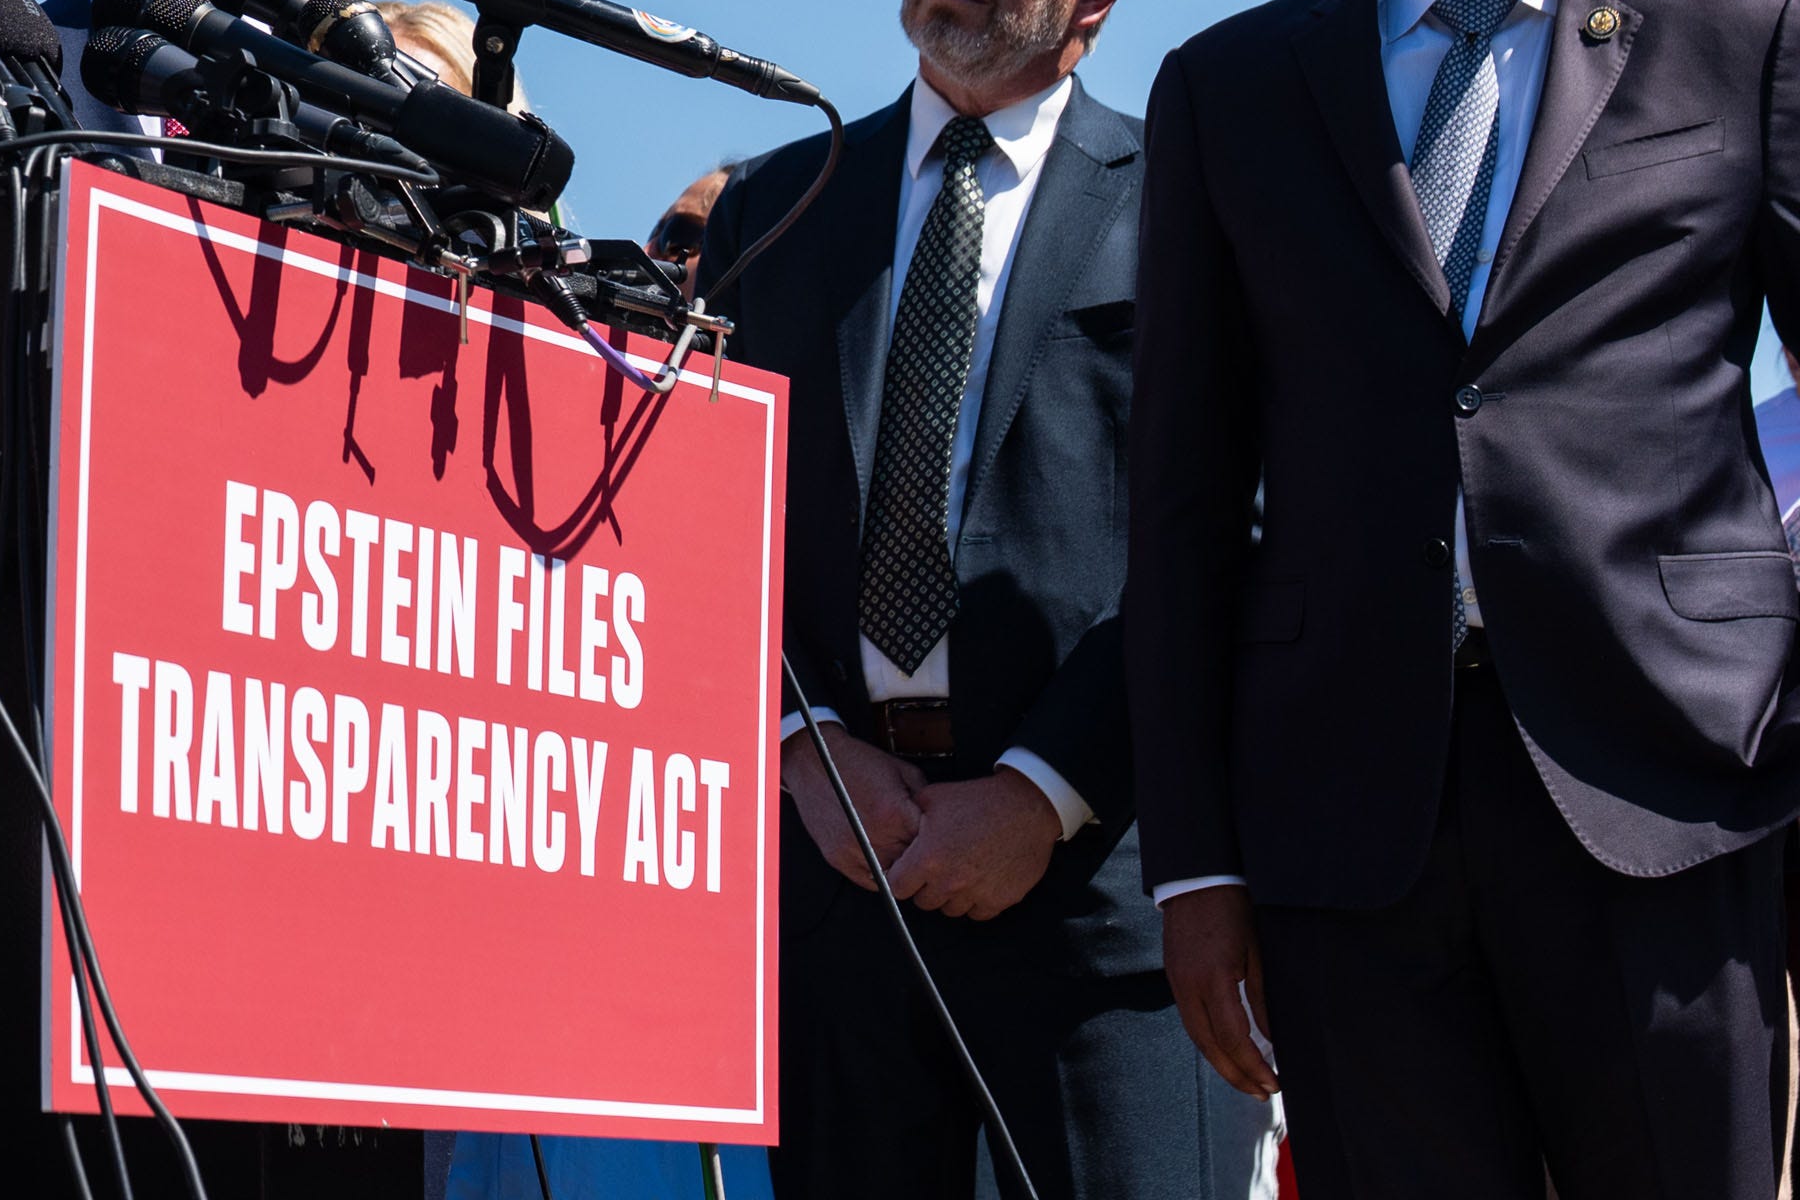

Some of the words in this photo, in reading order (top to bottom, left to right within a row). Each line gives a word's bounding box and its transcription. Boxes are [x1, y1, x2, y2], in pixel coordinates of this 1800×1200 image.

[222, 480, 478, 677] EPSTEIN
[495, 544, 646, 709] FILES
[112, 651, 608, 878] TRANSPARENCY
[623, 748, 730, 894] ACT
